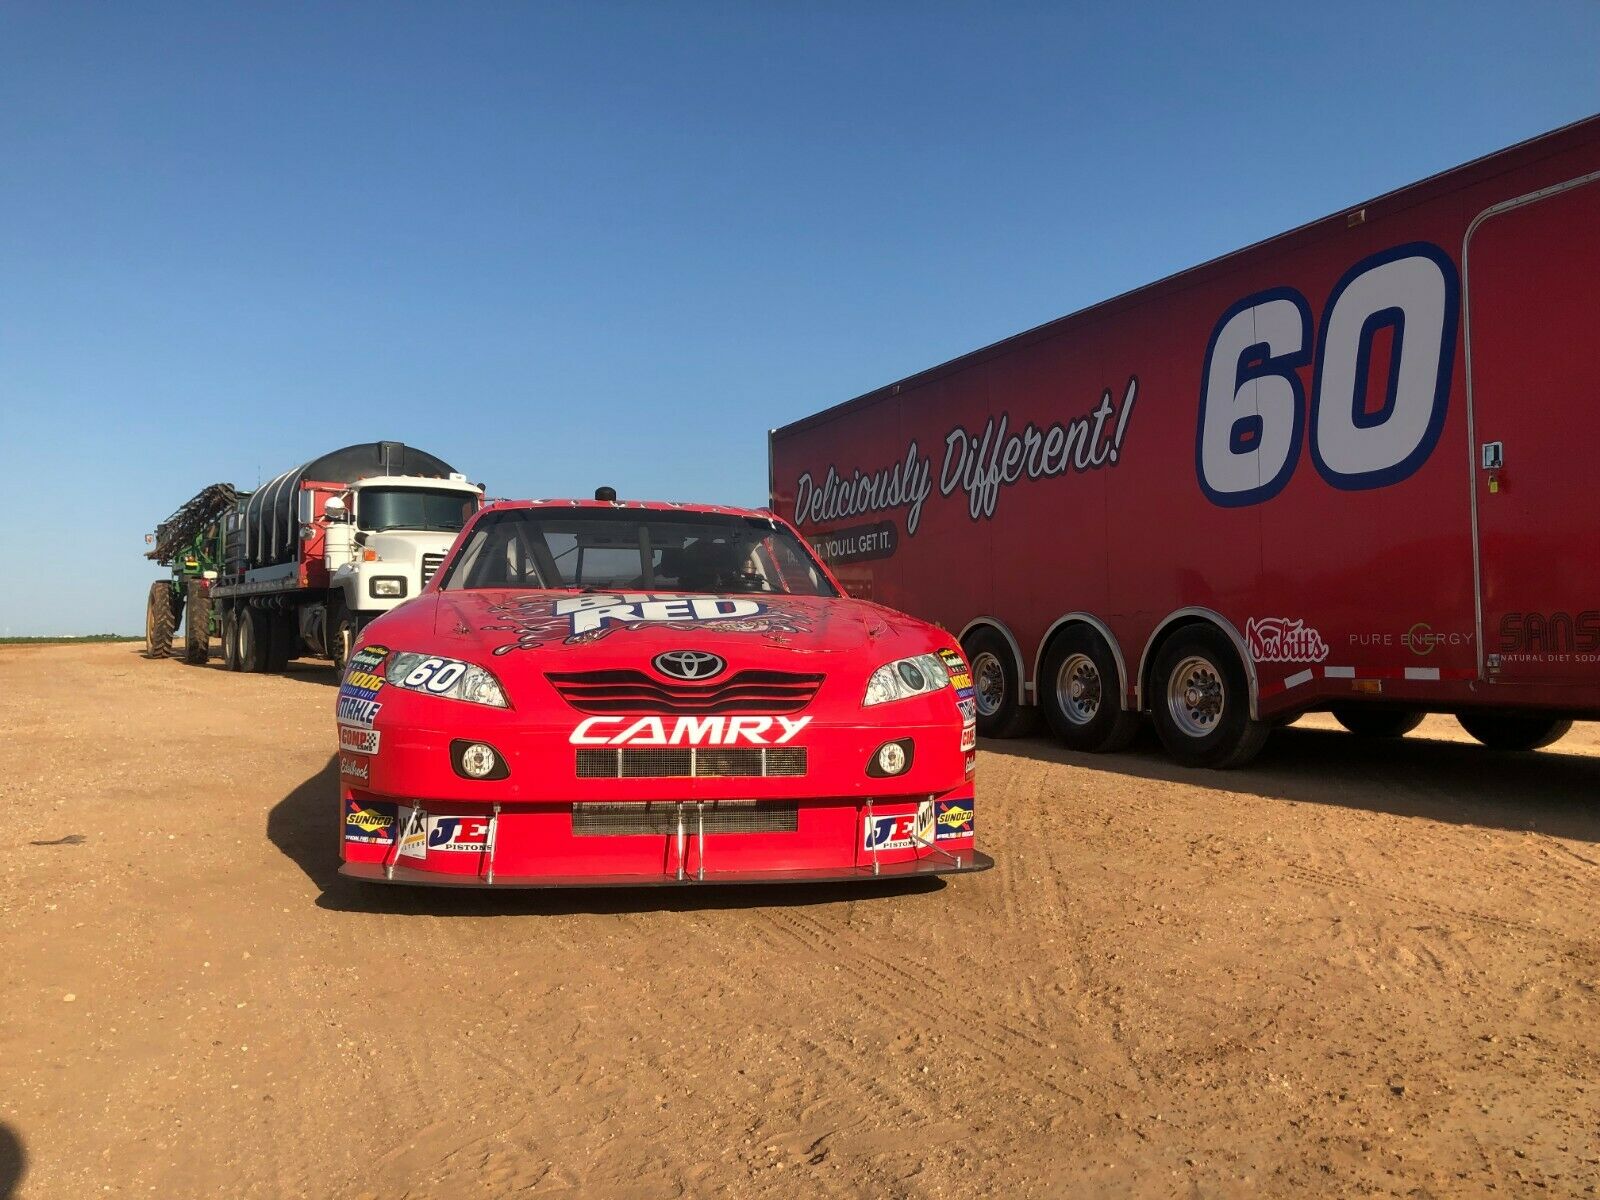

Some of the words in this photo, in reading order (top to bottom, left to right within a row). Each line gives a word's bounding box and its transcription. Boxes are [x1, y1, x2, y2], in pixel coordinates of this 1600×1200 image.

[1196, 242, 1459, 506] 60
[794, 441, 932, 534] Deliciously
[940, 378, 1138, 520] Different!
[826, 539, 856, 557] YOU'LL
[859, 532, 877, 553] GET
[880, 531, 891, 548] IT.
[573, 599, 760, 635] RED
[1350, 633, 1392, 646] PURE
[1400, 632, 1474, 646] ENERGY
[1500, 654, 1543, 662] NATURAL
[1547, 654, 1571, 662] DIET
[346, 671, 386, 691] MOOG
[404, 659, 467, 693] 60
[337, 697, 380, 723] MAHLE
[342, 729, 367, 746] COMP
[568, 716, 812, 744] CAMRY
[349, 814, 391, 826] SUNOCO
[918, 805, 934, 831] WIX
[940, 811, 972, 823] SUNOCO
[428, 816, 490, 848] JE
[866, 815, 916, 848] JE
